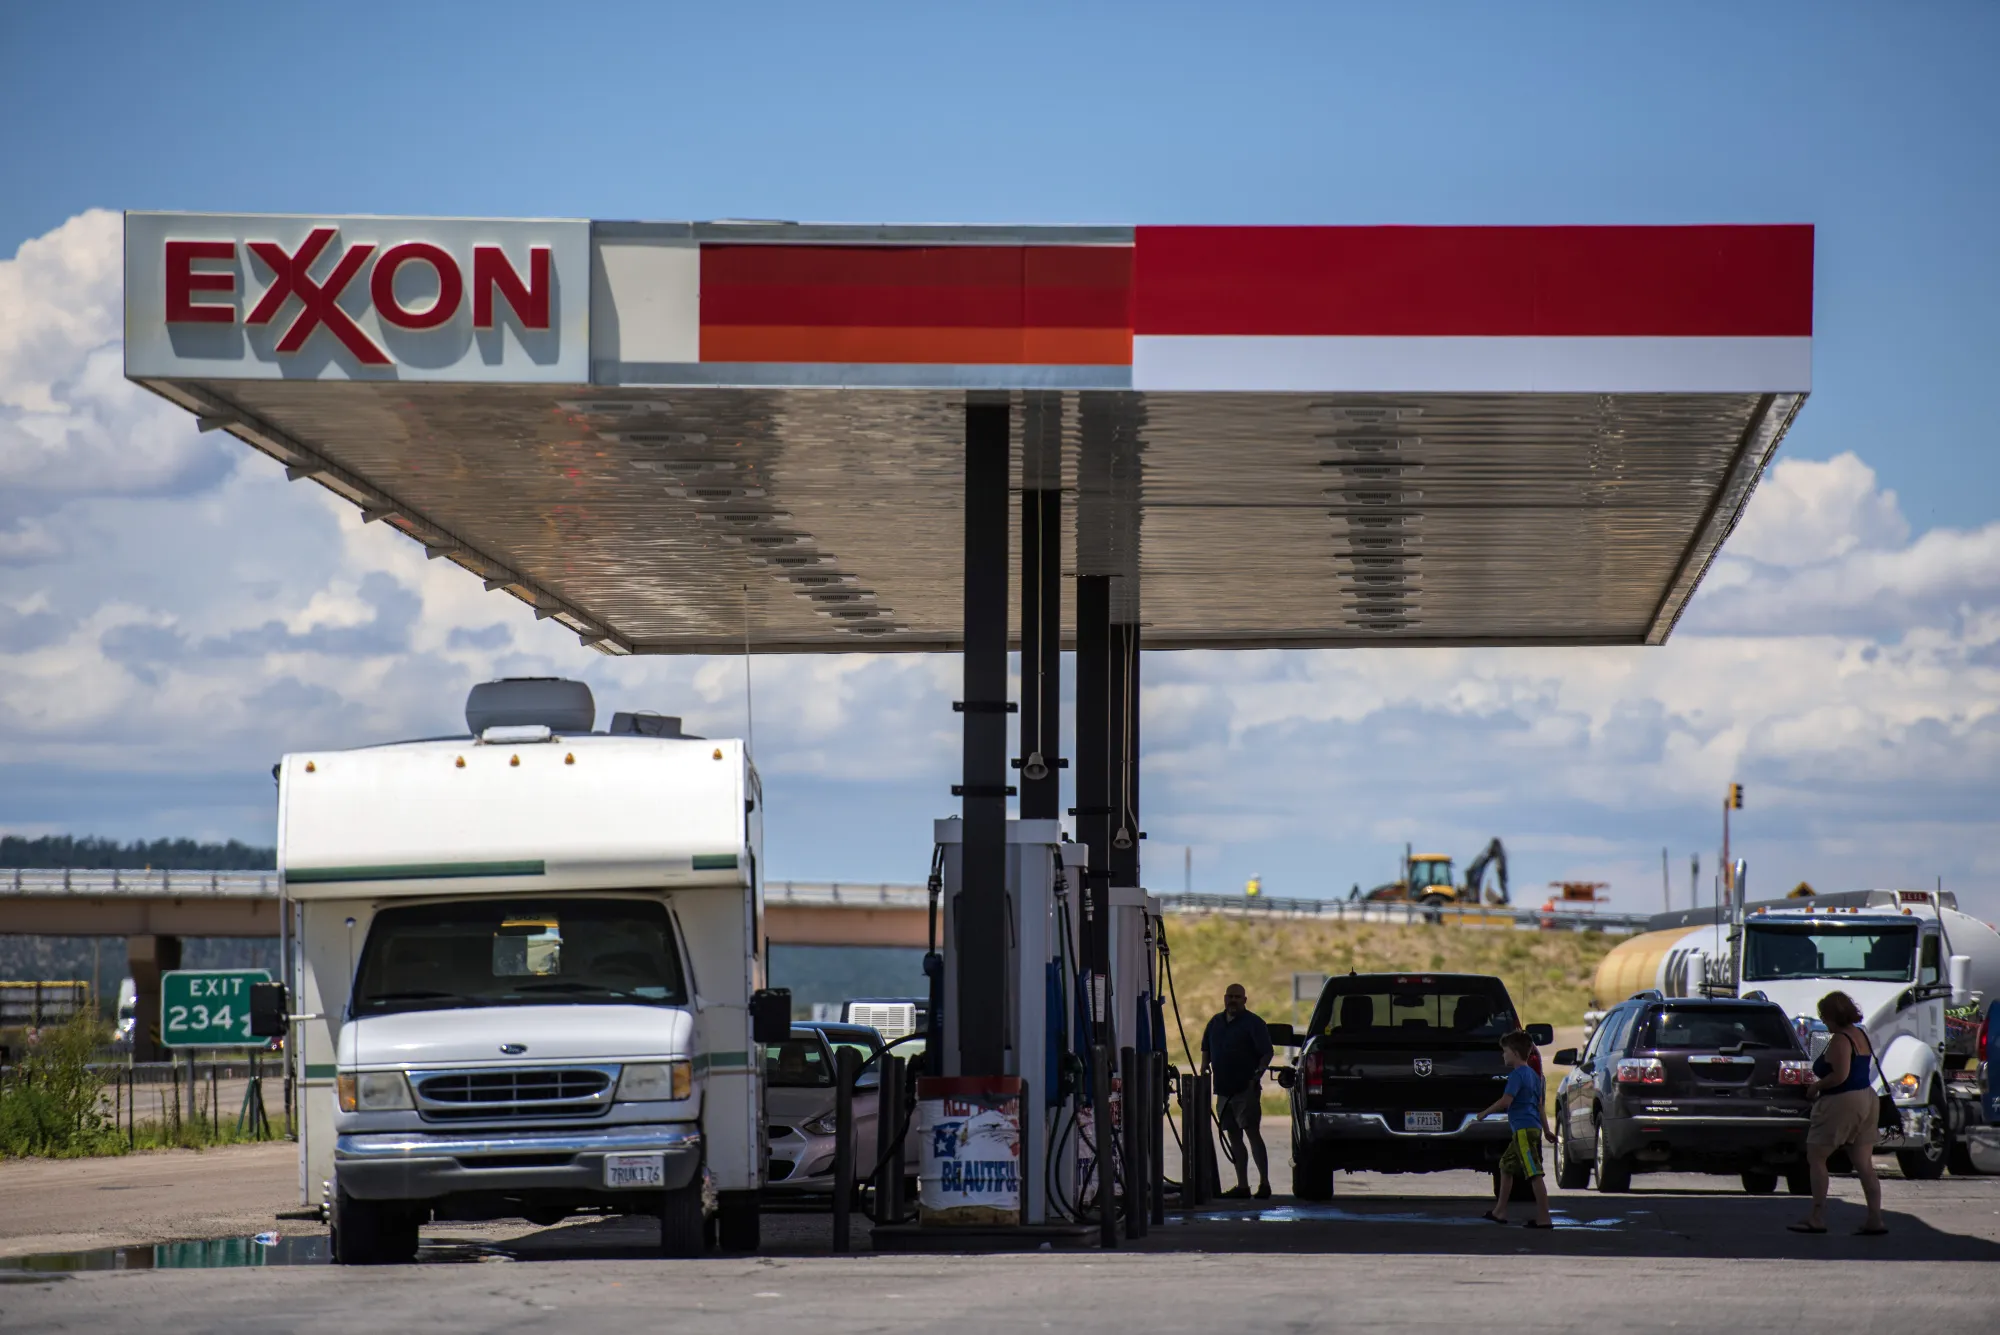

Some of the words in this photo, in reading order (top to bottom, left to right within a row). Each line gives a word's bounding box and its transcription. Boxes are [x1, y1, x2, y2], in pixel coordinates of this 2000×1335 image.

[165, 227, 552, 365] EXXON
[190, 978, 244, 997] EXIT
[168, 1004, 234, 1032] 234
